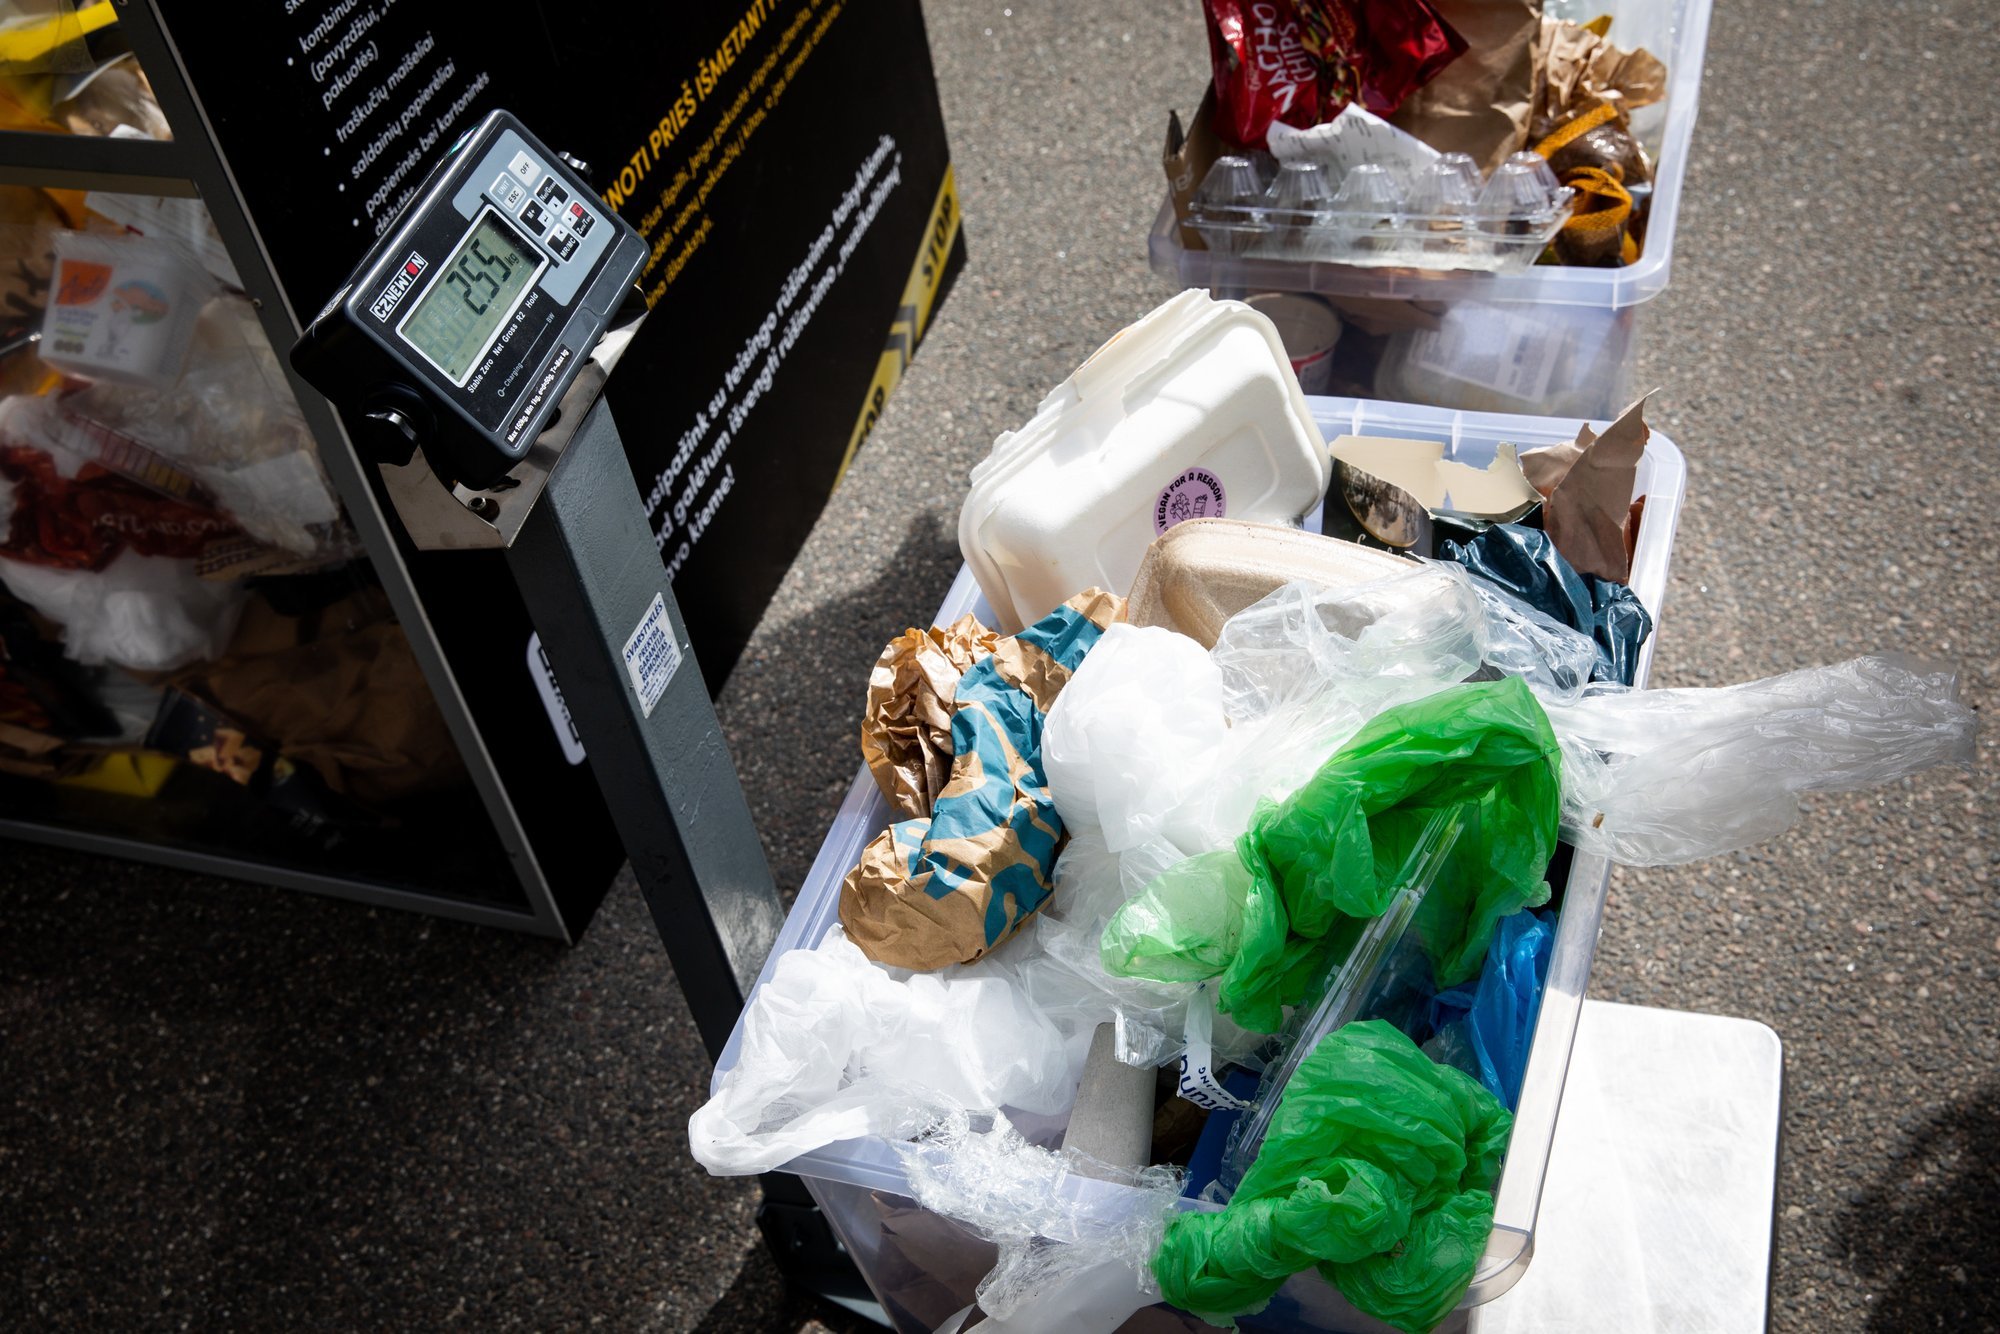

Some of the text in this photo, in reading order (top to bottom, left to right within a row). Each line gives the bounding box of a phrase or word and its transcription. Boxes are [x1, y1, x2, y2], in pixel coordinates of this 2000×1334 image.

[310, 4, 380, 83] (pavyzdžiui,
[1252, 3, 1298, 115] NACHO
[1276, 22, 1317, 82] CHIPS
[321, 40, 379, 111] pakuotės)
[335, 30, 435, 143] traškučių maišeliai
[351, 58, 456, 180] saldainių popierėliai
[365, 71, 490, 219] popierinės bei kartoninės
[649, 79, 698, 161] PRIEŠ
[498, 180, 510, 195] UNIT
[508, 190, 520, 204] ESC
[520, 162, 530, 175] OFF
[504, 252, 520, 267] kg
[560, 237, 576, 258] MR/MC
[921, 193, 953, 288] STOP
[467, 291, 539, 394] Stable Zero Net Gross R2 Hold
[708, 387, 727, 419] su
[724, 311, 778, 393] teisingo
[775, 224, 835, 318] rūšiavimo
[505, 362, 524, 387] Charging
[673, 430, 731, 527] galėtum
[727, 346, 781, 435] išvengti
[778, 265, 837, 360] rūšiavimo
[507, 430, 518, 443] Max
[524, 405, 534, 416] Min
[687, 463, 736, 545] kieme!
[1158, 472, 1222, 528] VEGAN FOR A REASON
[626, 600, 663, 663] SVARSTYKLĖS
[638, 625, 660, 661] PREKYBA
[638, 630, 666, 675] GARANTIJA
[641, 640, 668, 683] REMONTAS
